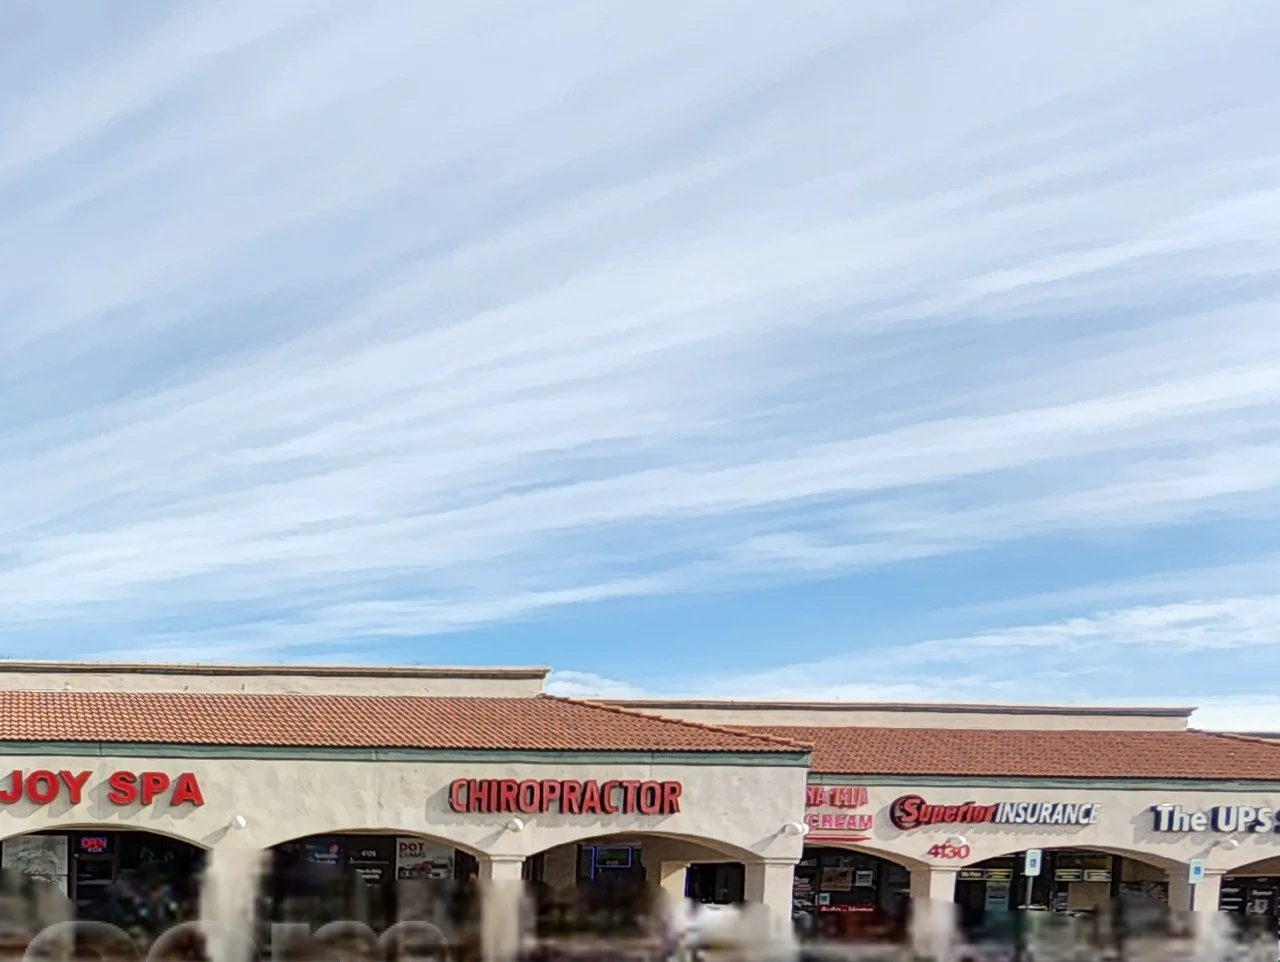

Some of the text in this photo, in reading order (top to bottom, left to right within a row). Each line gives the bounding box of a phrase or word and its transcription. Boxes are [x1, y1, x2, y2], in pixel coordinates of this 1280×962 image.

[107, 772, 205, 807] SPA
[449, 778, 682, 815] CHIROPRACTOR
[807, 813, 873, 831] CREAM
[894, 797, 1101, 826] Superior INSURANCE
[1150, 804, 1208, 832] The
[1212, 805, 1273, 833] UPS
[81, 838, 107, 848] OPEN
[399, 842, 425, 852] DOT
